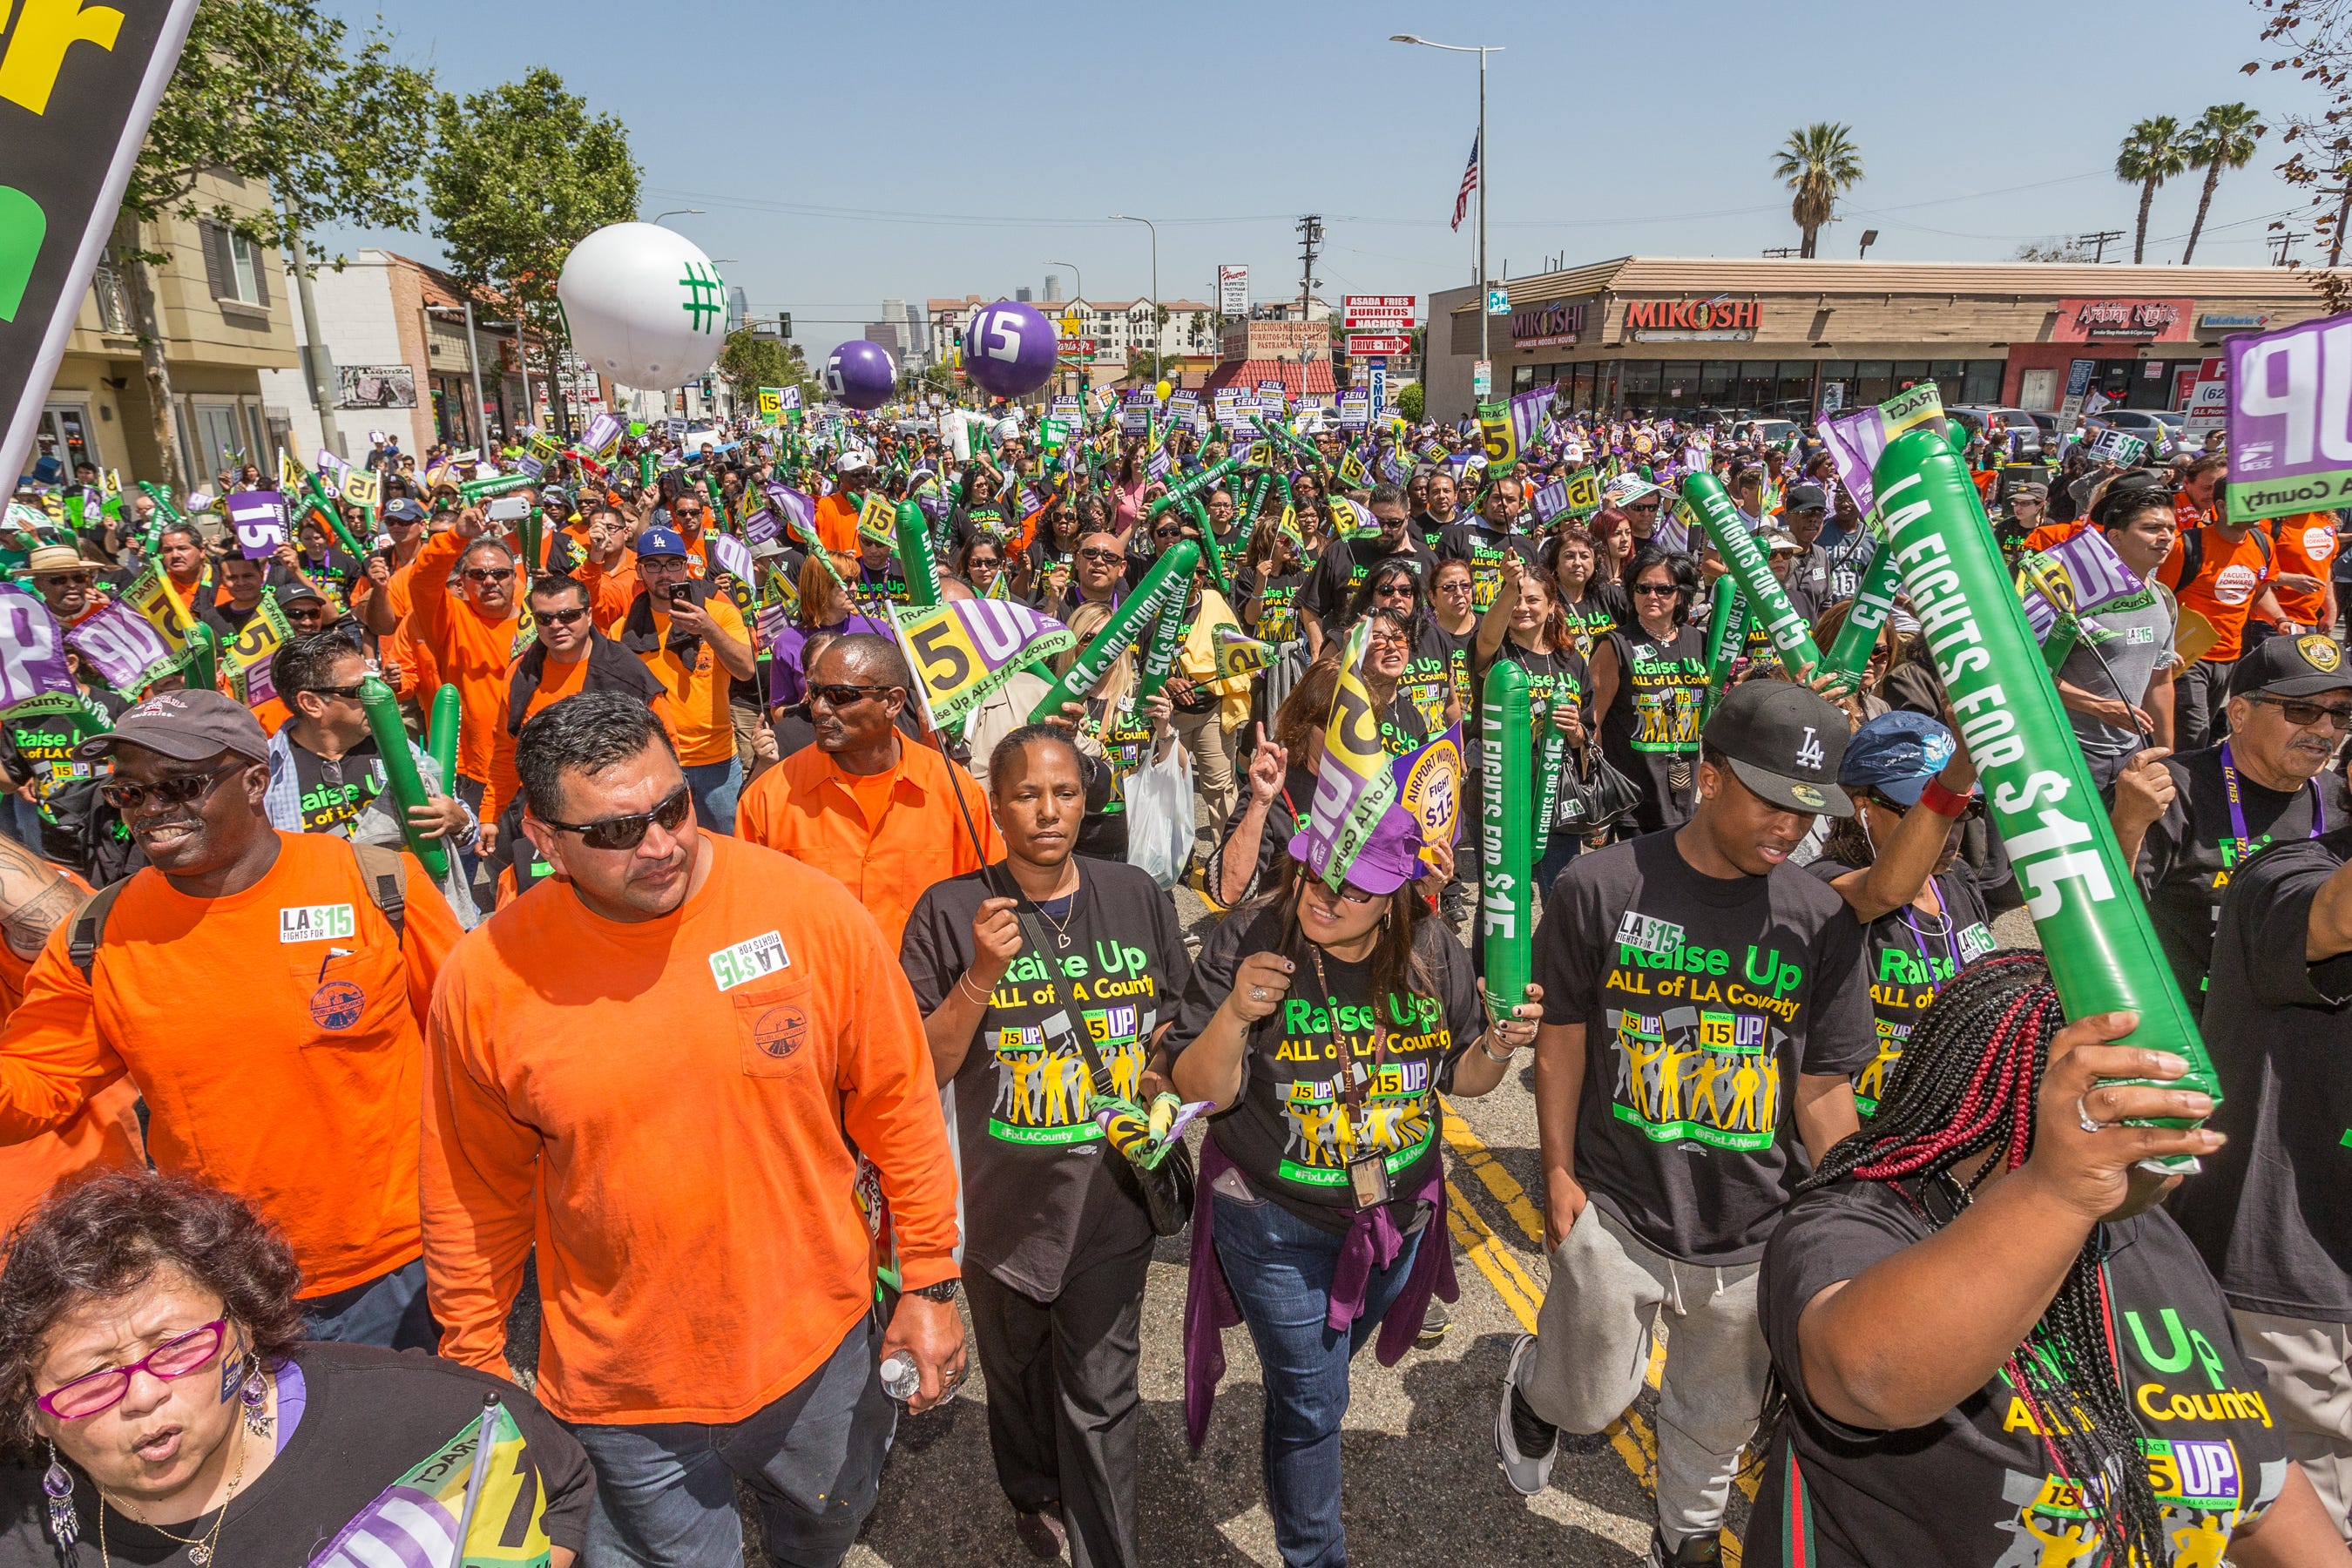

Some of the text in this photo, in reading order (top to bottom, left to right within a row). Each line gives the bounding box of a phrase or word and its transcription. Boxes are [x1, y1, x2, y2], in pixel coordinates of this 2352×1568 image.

[1355, 320, 1403, 328] NACHOS
[1510, 304, 1584, 337] MIKOSHI
[1625, 299, 1763, 330] MIKOSHI
[2080, 302, 2181, 327] Arabian Nights
[1283, 323, 1311, 332] MEXICAN
[1313, 323, 1328, 332] FOOD
[1351, 341, 1403, 349] DRIVE THRU
[1515, 339, 1538, 348] JAPANESE
[1173, 389, 1197, 399] SEIU
[1216, 388, 1239, 396] SEIU
[1261, 381, 1283, 389] SEIU
[762, 395, 778, 410] 15
[1055, 395, 1078, 404] SEIU
[1126, 395, 1151, 404] SEIU
[1235, 397, 1260, 406] SEIU
[1381, 406, 1401, 415] SEIU
[1660, 427, 1672, 439] 15
[2094, 429, 2146, 463] IE $15
[1217, 463, 1229, 475] LA
[1344, 456, 1362, 478] 15
[1500, 463, 1514, 474] ALL
[867, 504, 892, 531] 15
[1876, 473, 1932, 541] LA
[232, 502, 284, 549] 15
[746, 510, 779, 539] UP
[653, 535, 666, 548] LA
[1474, 545, 1504, 559] Raise
[1702, 491, 1808, 651] LA FIGHTS FOR $15
[1851, 579, 1903, 630] $15
[1896, 532, 1991, 688] FIGHTS
[2114, 596, 2151, 609] County
[1588, 612, 1611, 626] Up
[1064, 588, 1172, 697] FIGHTS FOR $15
[1145, 619, 1178, 676] FOR $15
[1718, 631, 1743, 663] $15
[950, 635, 1067, 712] Up ALL County
[1416, 657, 1442, 674] Up
[1418, 672, 1448, 682] County
[1633, 657, 1707, 679] Raise Up
[1631, 675, 1682, 686] ALL of LA
[1415, 689, 1425, 699] 15
[16, 729, 71, 747] Raise
[1114, 730, 1151, 742] County
[1950, 683, 2025, 778] FOR
[44, 748, 64, 759] LA
[1796, 726, 1825, 771] LA
[1407, 754, 1436, 803] AIRPORT
[1429, 774, 1450, 798] FIGHT
[2224, 766, 2240, 804] SEIU 721
[1536, 739, 1565, 849] LA FIGHTS FOR $15
[1426, 791, 1453, 828] $15
[1483, 704, 1516, 939] LA FIGHTS FOR $15
[1995, 769, 2117, 922] $15
[283, 906, 353, 936] LA $15
[1620, 914, 1681, 953] LA $15
[283, 929, 324, 941] FIGHTS FOR
[739, 933, 780, 956] FIGHTS FOR
[1617, 932, 1639, 947] FIGHTS
[1968, 924, 1995, 952] $15
[713, 943, 788, 989] LA $15
[1096, 940, 1147, 979] Up
[1745, 944, 1802, 999] Up
[1879, 948, 1956, 985] Raise
[989, 974, 1153, 1009] ALL County
[1605, 969, 1801, 1022] ALL of LA County
[1869, 983, 1909, 1009] ALL
[313, 1006, 337, 1016] PUBLIC
[1107, 1007, 1135, 1038] UP
[1285, 992, 1443, 1035] Raise Up
[1004, 1027, 1040, 1044] 15 UP
[1625, 1015, 1660, 1034] 15 UP
[1707, 1016, 1763, 1045] 15 UP
[755, 1034, 781, 1043] PUBLIC
[1275, 1029, 1451, 1061] ALL County
[1295, 1081, 1332, 1098] 15 UP
[1376, 1062, 1427, 1093] 15 UP
[1001, 1127, 1073, 1142] #FixLACounty
[1694, 1127, 1761, 1148] @FixLANow
[2124, 1308, 2226, 1390] Up
[2137, 1382, 2274, 1428] County
[2175, 1443, 2234, 1497] UP
[2203, 1499, 2234, 1509] County
